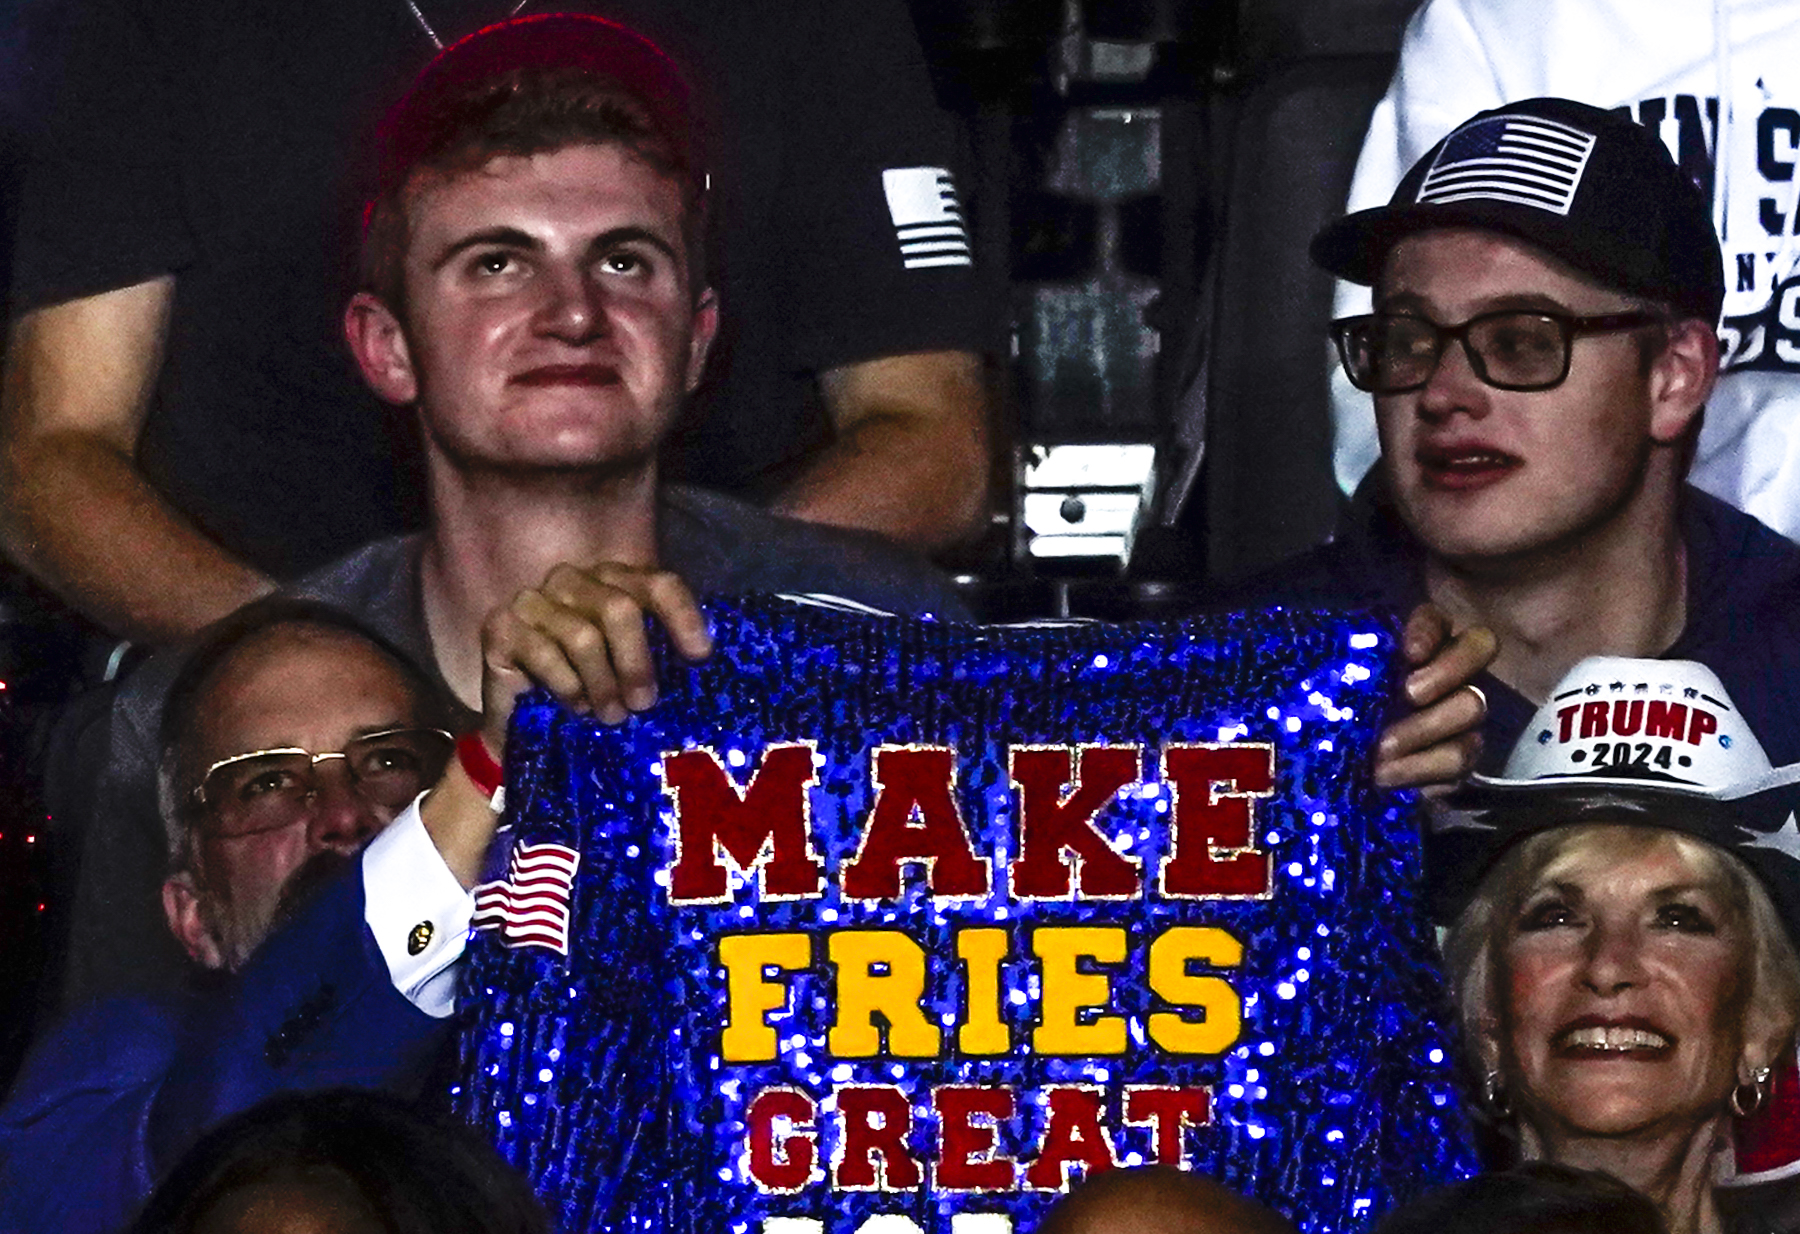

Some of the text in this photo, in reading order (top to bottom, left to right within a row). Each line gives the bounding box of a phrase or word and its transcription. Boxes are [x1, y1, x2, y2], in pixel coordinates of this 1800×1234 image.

[1557, 699, 1718, 746] TRUMP
[1591, 742, 1673, 769] 2024
[661, 739, 1275, 905] MAKE
[718, 926, 1245, 1062] FRIES
[743, 1083, 1213, 1194] GREAT
